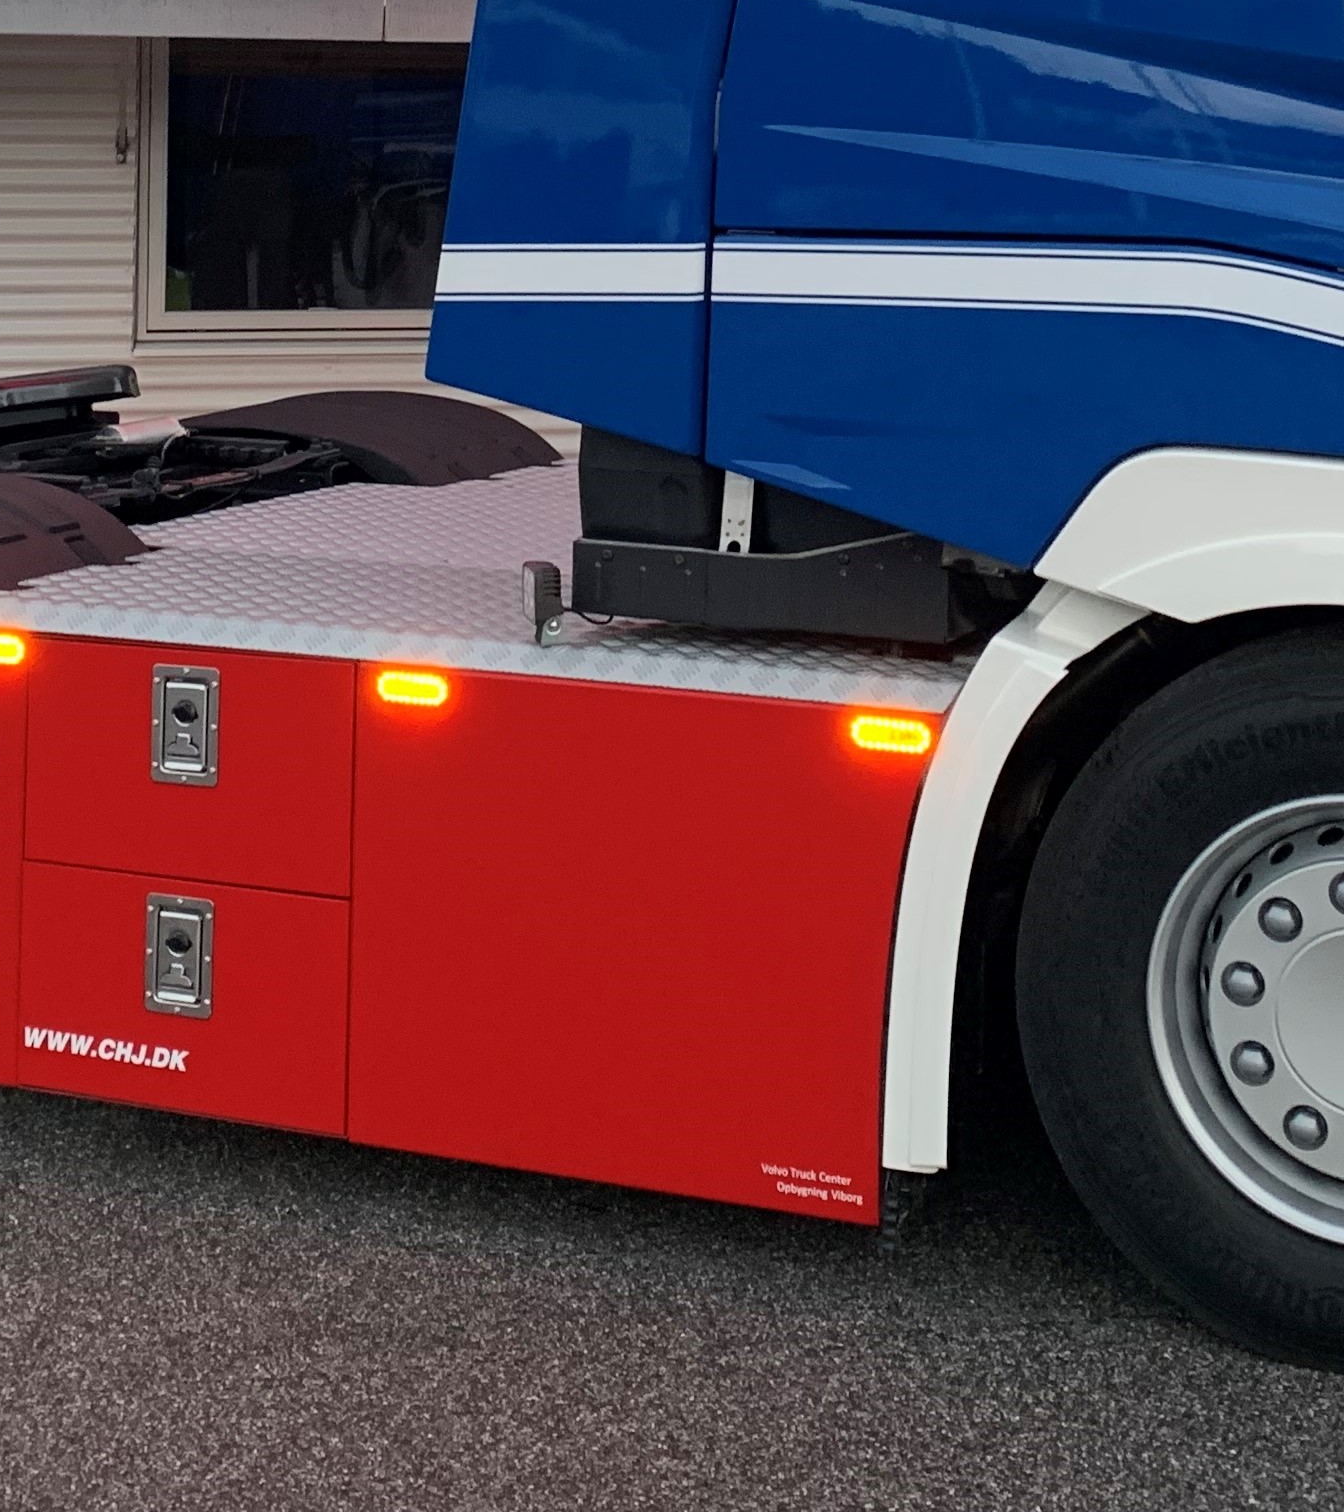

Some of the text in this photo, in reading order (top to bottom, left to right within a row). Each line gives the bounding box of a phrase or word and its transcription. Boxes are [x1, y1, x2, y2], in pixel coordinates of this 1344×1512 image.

[24, 1026, 190, 1073] WWW.CHJ.DK
[761, 1163, 851, 1186] Volvo Truck Center
[776, 1181, 863, 1205] Opbygning Viborg
